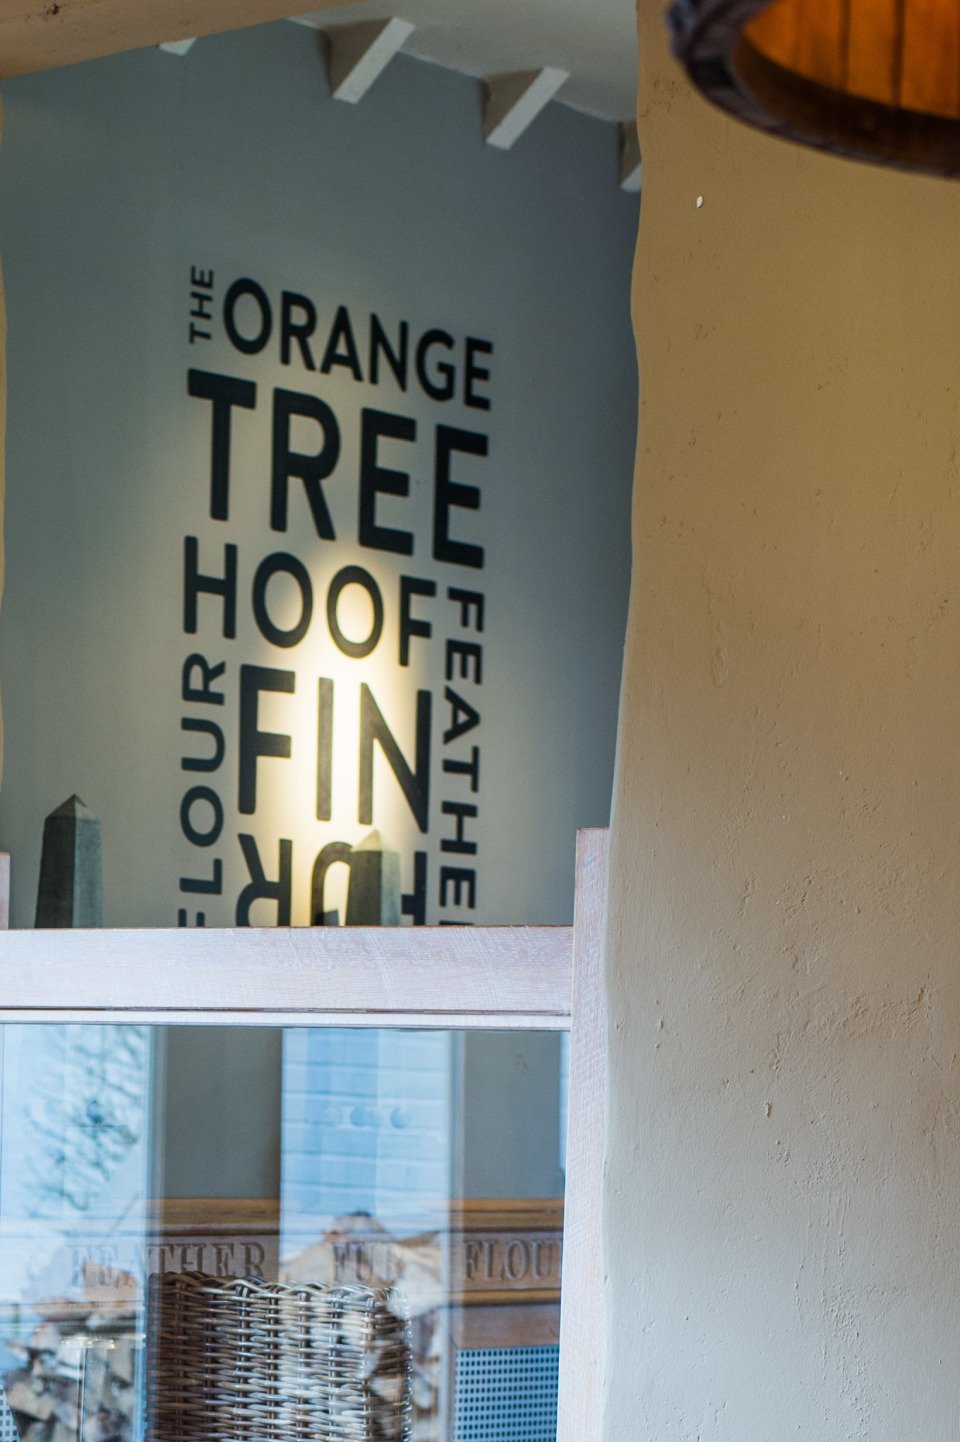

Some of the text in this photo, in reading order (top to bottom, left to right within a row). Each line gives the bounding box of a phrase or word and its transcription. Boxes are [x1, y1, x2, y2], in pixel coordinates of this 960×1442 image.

[189, 265, 214, 344] THE
[223, 277, 493, 410] ORANGE
[187, 367, 488, 570] TREE
[184, 535, 436, 667] HOOF
[238, 664, 432, 834] FIN
[439, 586, 486, 926] FEATHE
[464, 1238, 561, 1281] FLOU
